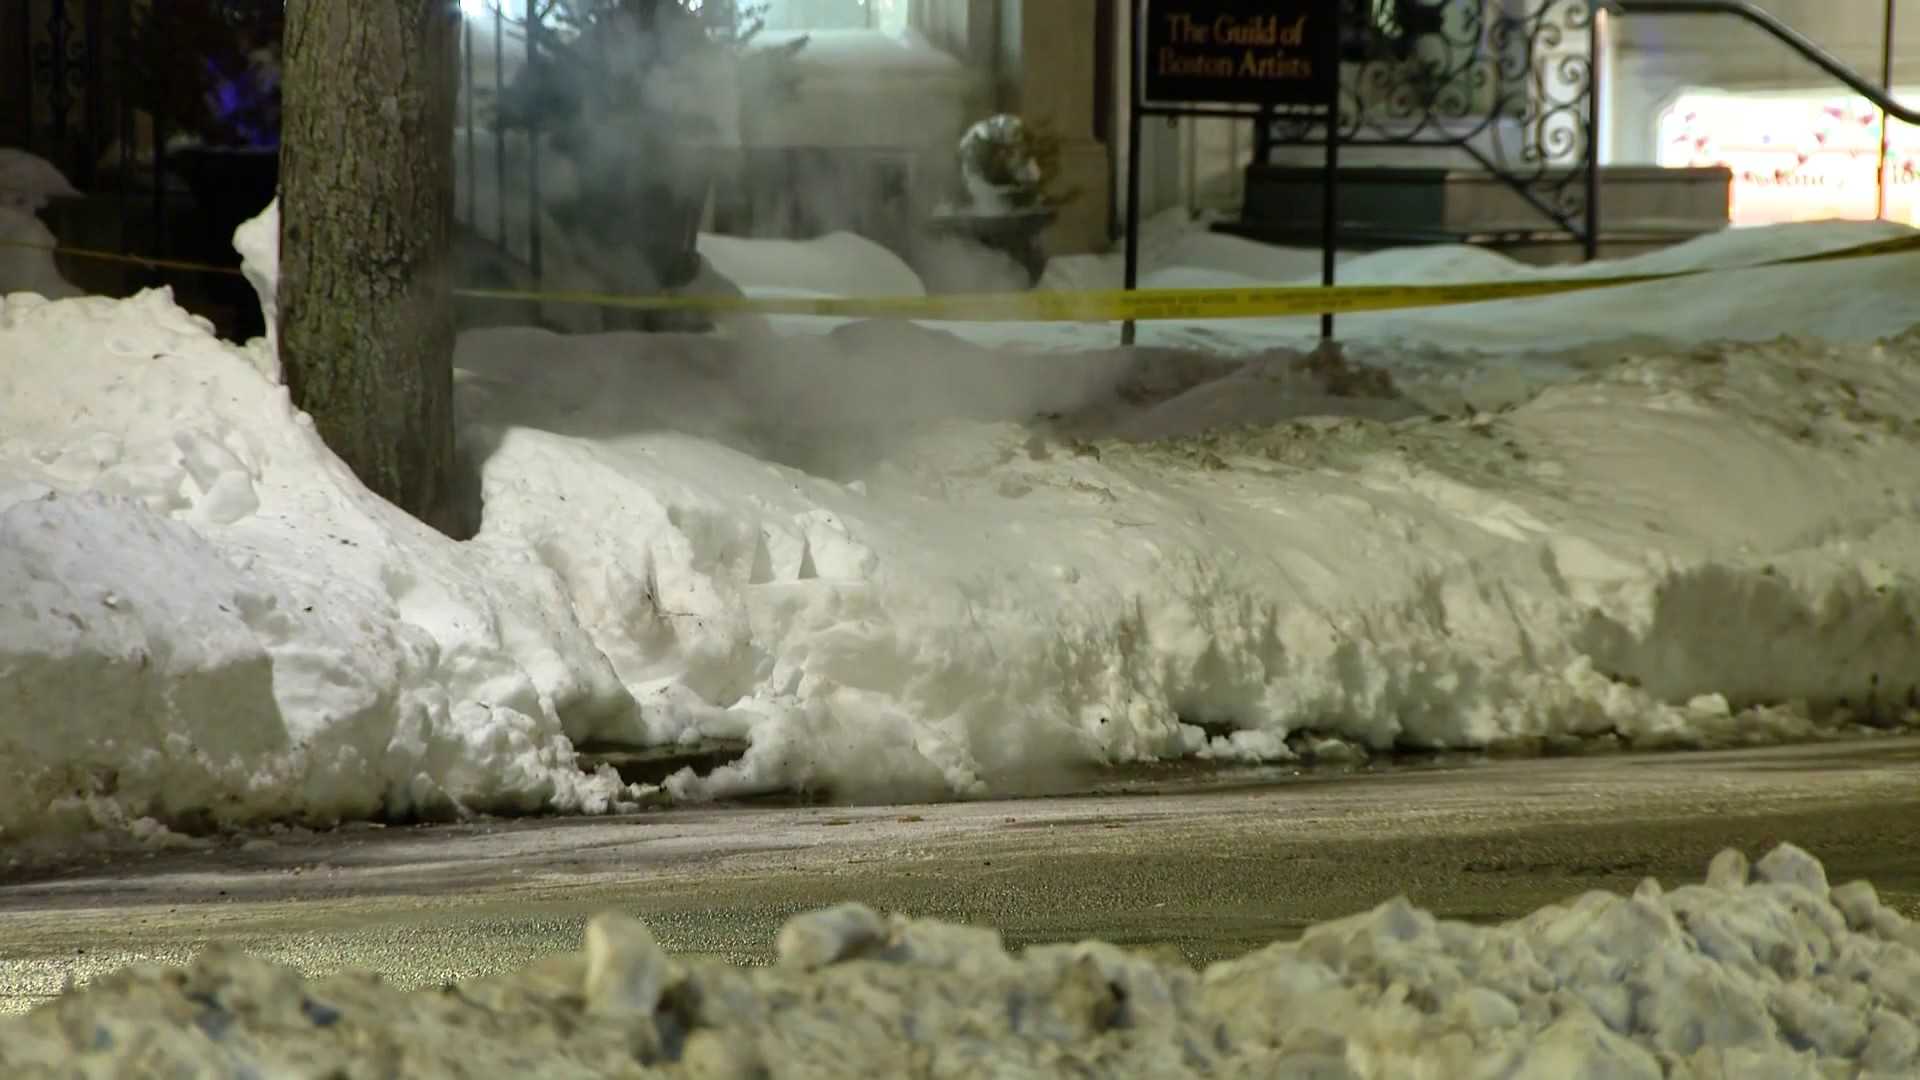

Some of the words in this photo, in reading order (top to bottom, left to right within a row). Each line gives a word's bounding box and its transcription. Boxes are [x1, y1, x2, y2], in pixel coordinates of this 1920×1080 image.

[1168, 14, 1209, 43] The
[1214, 14, 1278, 44] Guild
[1280, 14, 1308, 44] of
[1159, 48, 1233, 76] Boston
[1238, 48, 1312, 78] Artists
